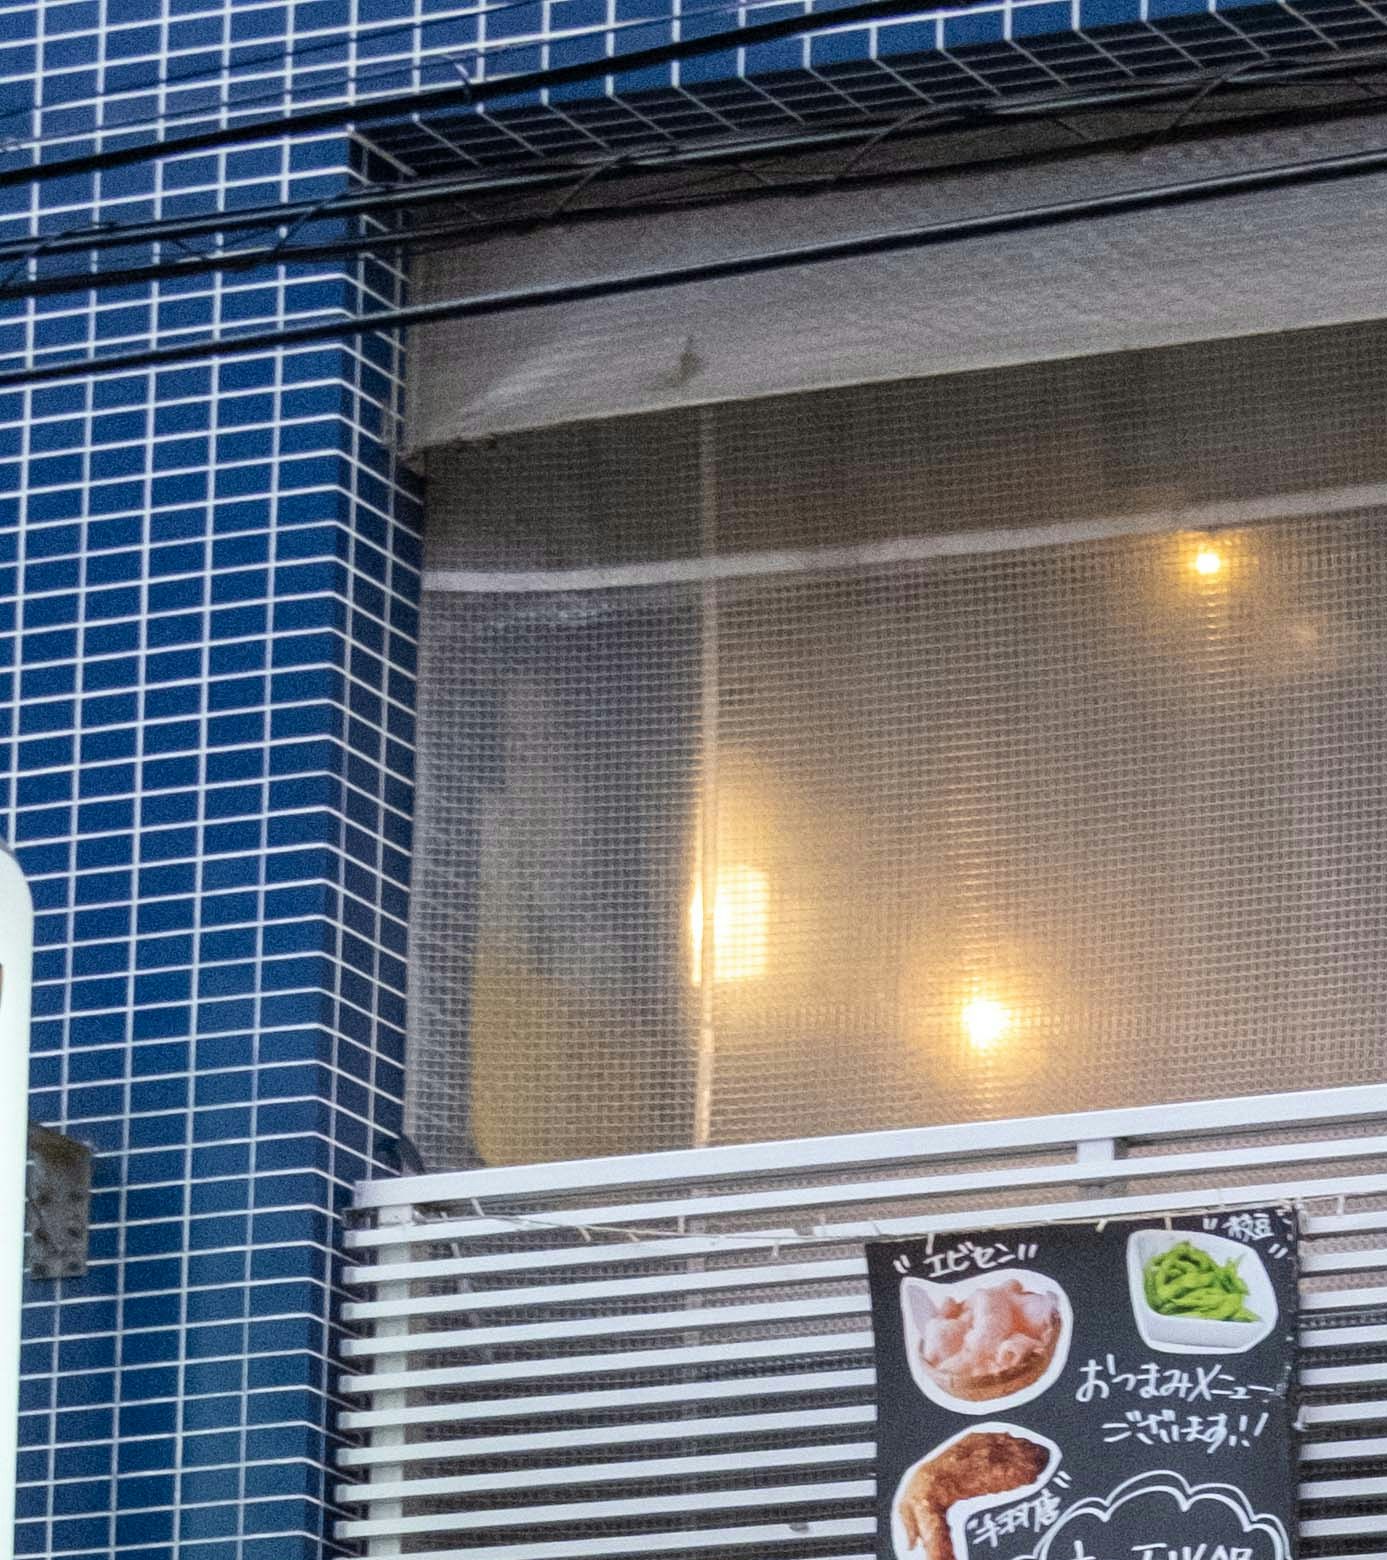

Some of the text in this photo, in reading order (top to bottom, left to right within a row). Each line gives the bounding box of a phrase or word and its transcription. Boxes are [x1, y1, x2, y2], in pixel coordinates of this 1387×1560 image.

[1076, 1354, 1276, 1402] おつまみメニュー
